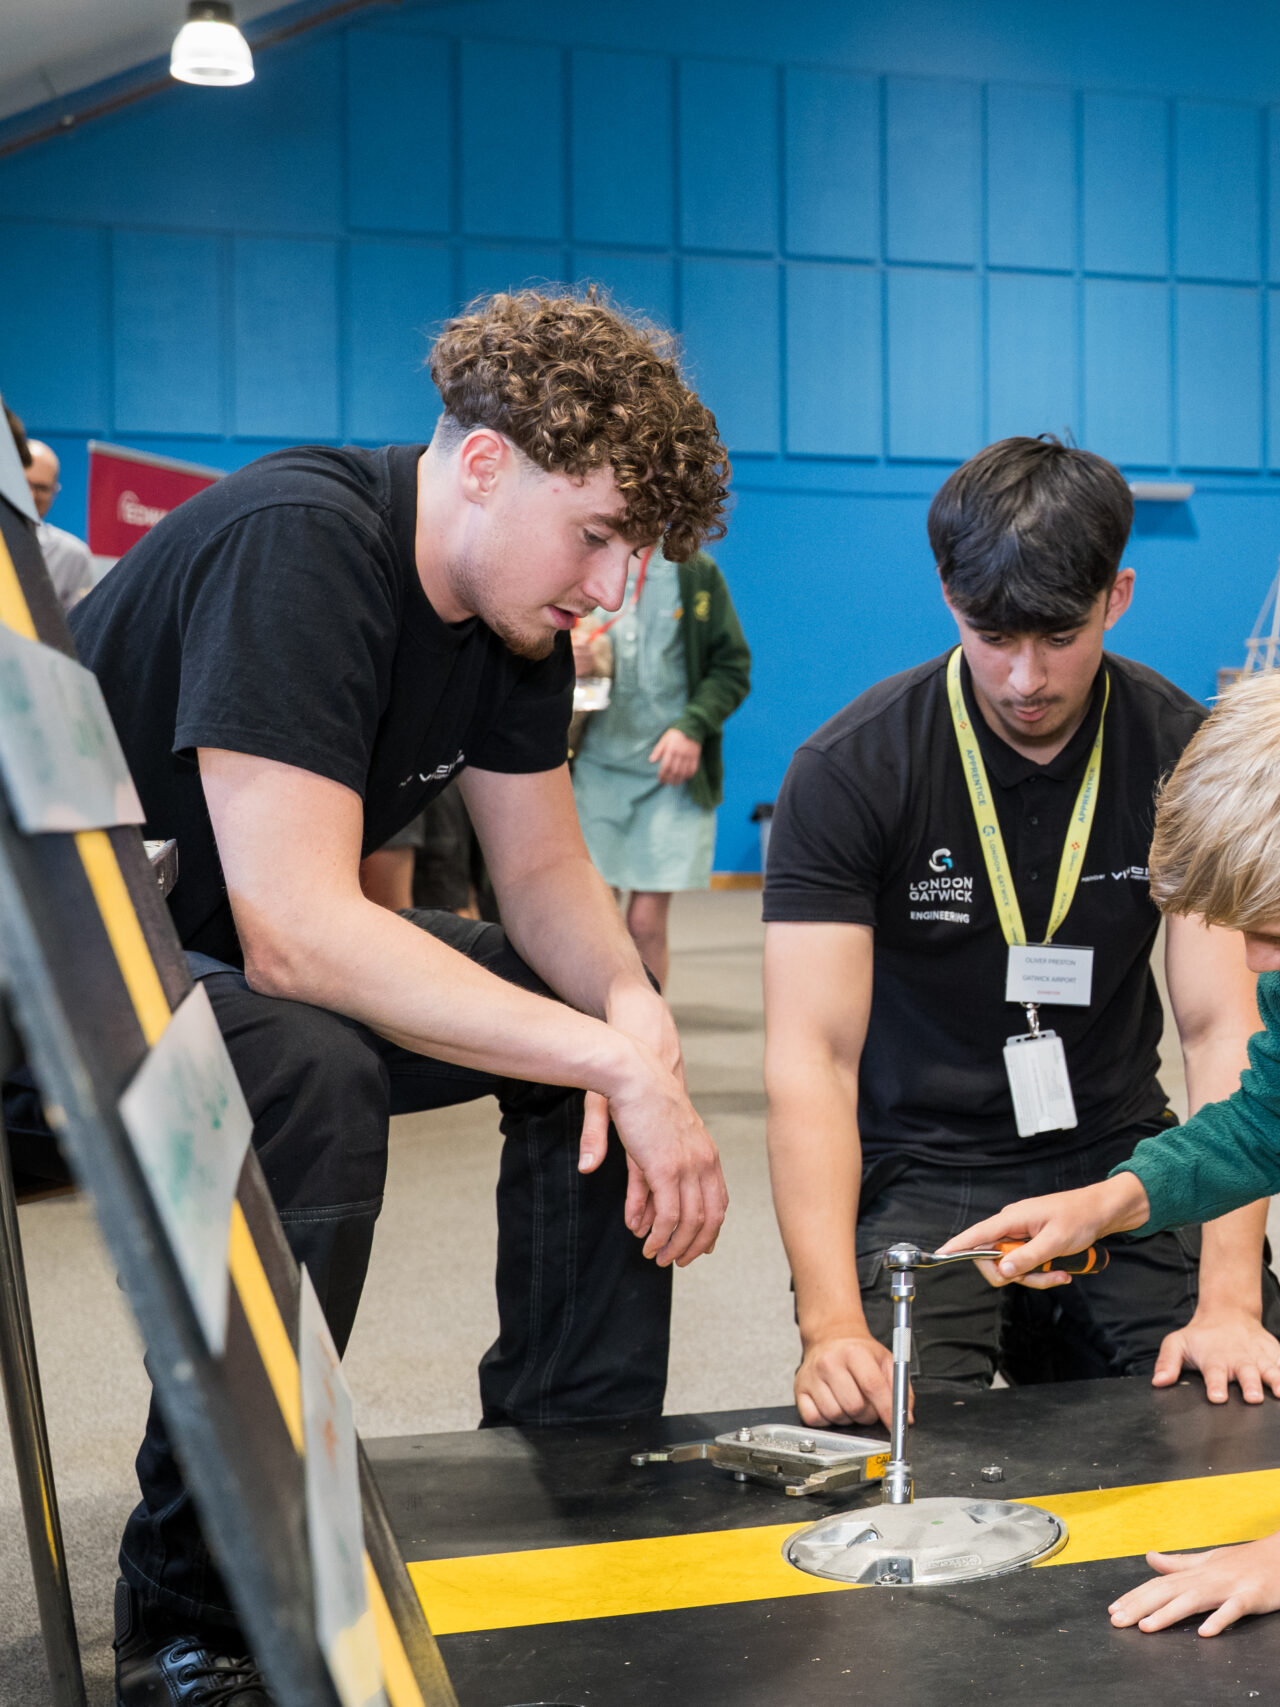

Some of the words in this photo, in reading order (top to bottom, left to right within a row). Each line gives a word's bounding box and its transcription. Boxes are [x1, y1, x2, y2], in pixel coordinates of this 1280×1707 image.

[966, 749, 986, 806] APPRENTICE
[1078, 767, 1095, 823] APPRENTICE
[989, 840, 1001, 872] LONDON
[909, 876, 973, 891] LONDON
[909, 889, 973, 903] GATWICK
[910, 910, 970, 924] ENGINEERING
